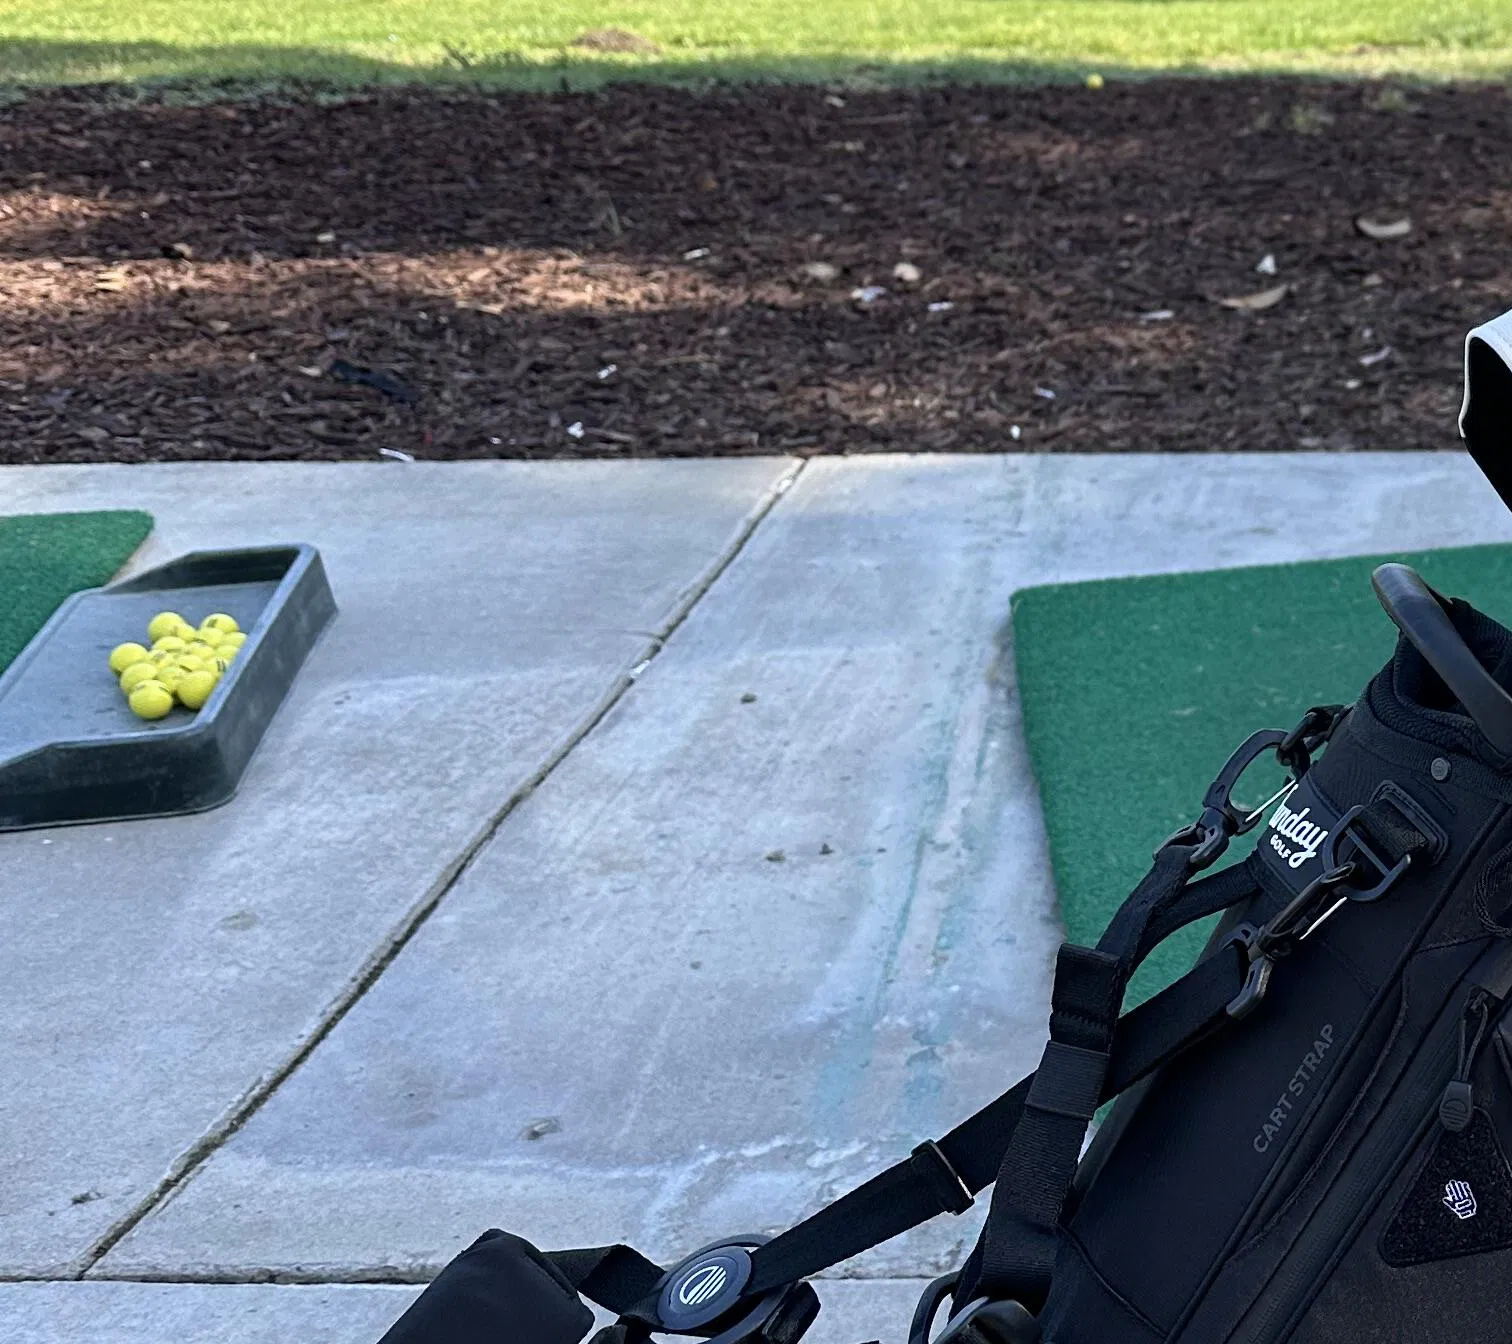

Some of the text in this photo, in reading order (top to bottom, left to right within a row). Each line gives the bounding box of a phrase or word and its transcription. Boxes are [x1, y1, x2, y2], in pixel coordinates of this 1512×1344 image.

[1270, 833, 1292, 859] GOLF
[1253, 1023, 1334, 1153] CART STRAP
